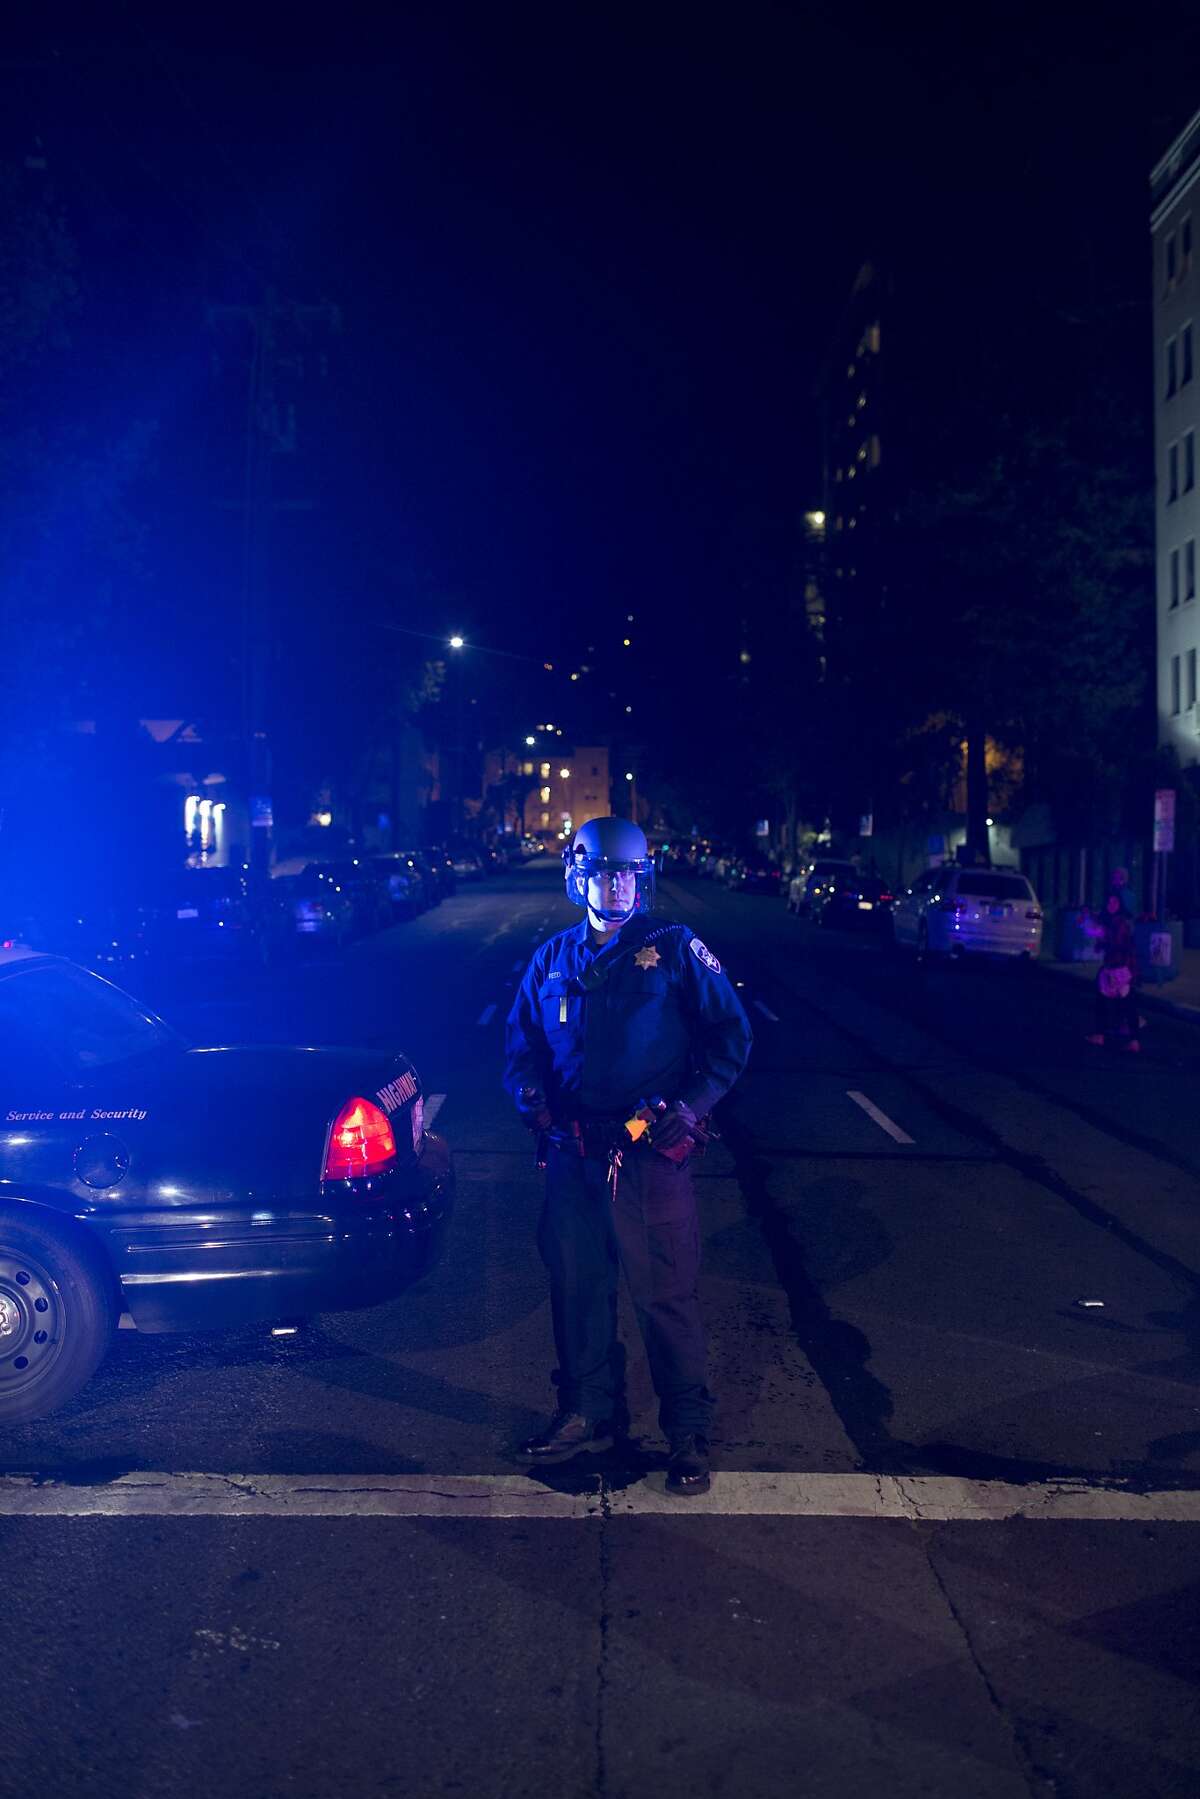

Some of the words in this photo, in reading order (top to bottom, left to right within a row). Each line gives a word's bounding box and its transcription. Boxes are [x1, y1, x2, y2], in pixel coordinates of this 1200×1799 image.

[6, 1110, 54, 1121] Service
[59, 1109, 86, 1120] and
[90, 1108, 147, 1120] Security
